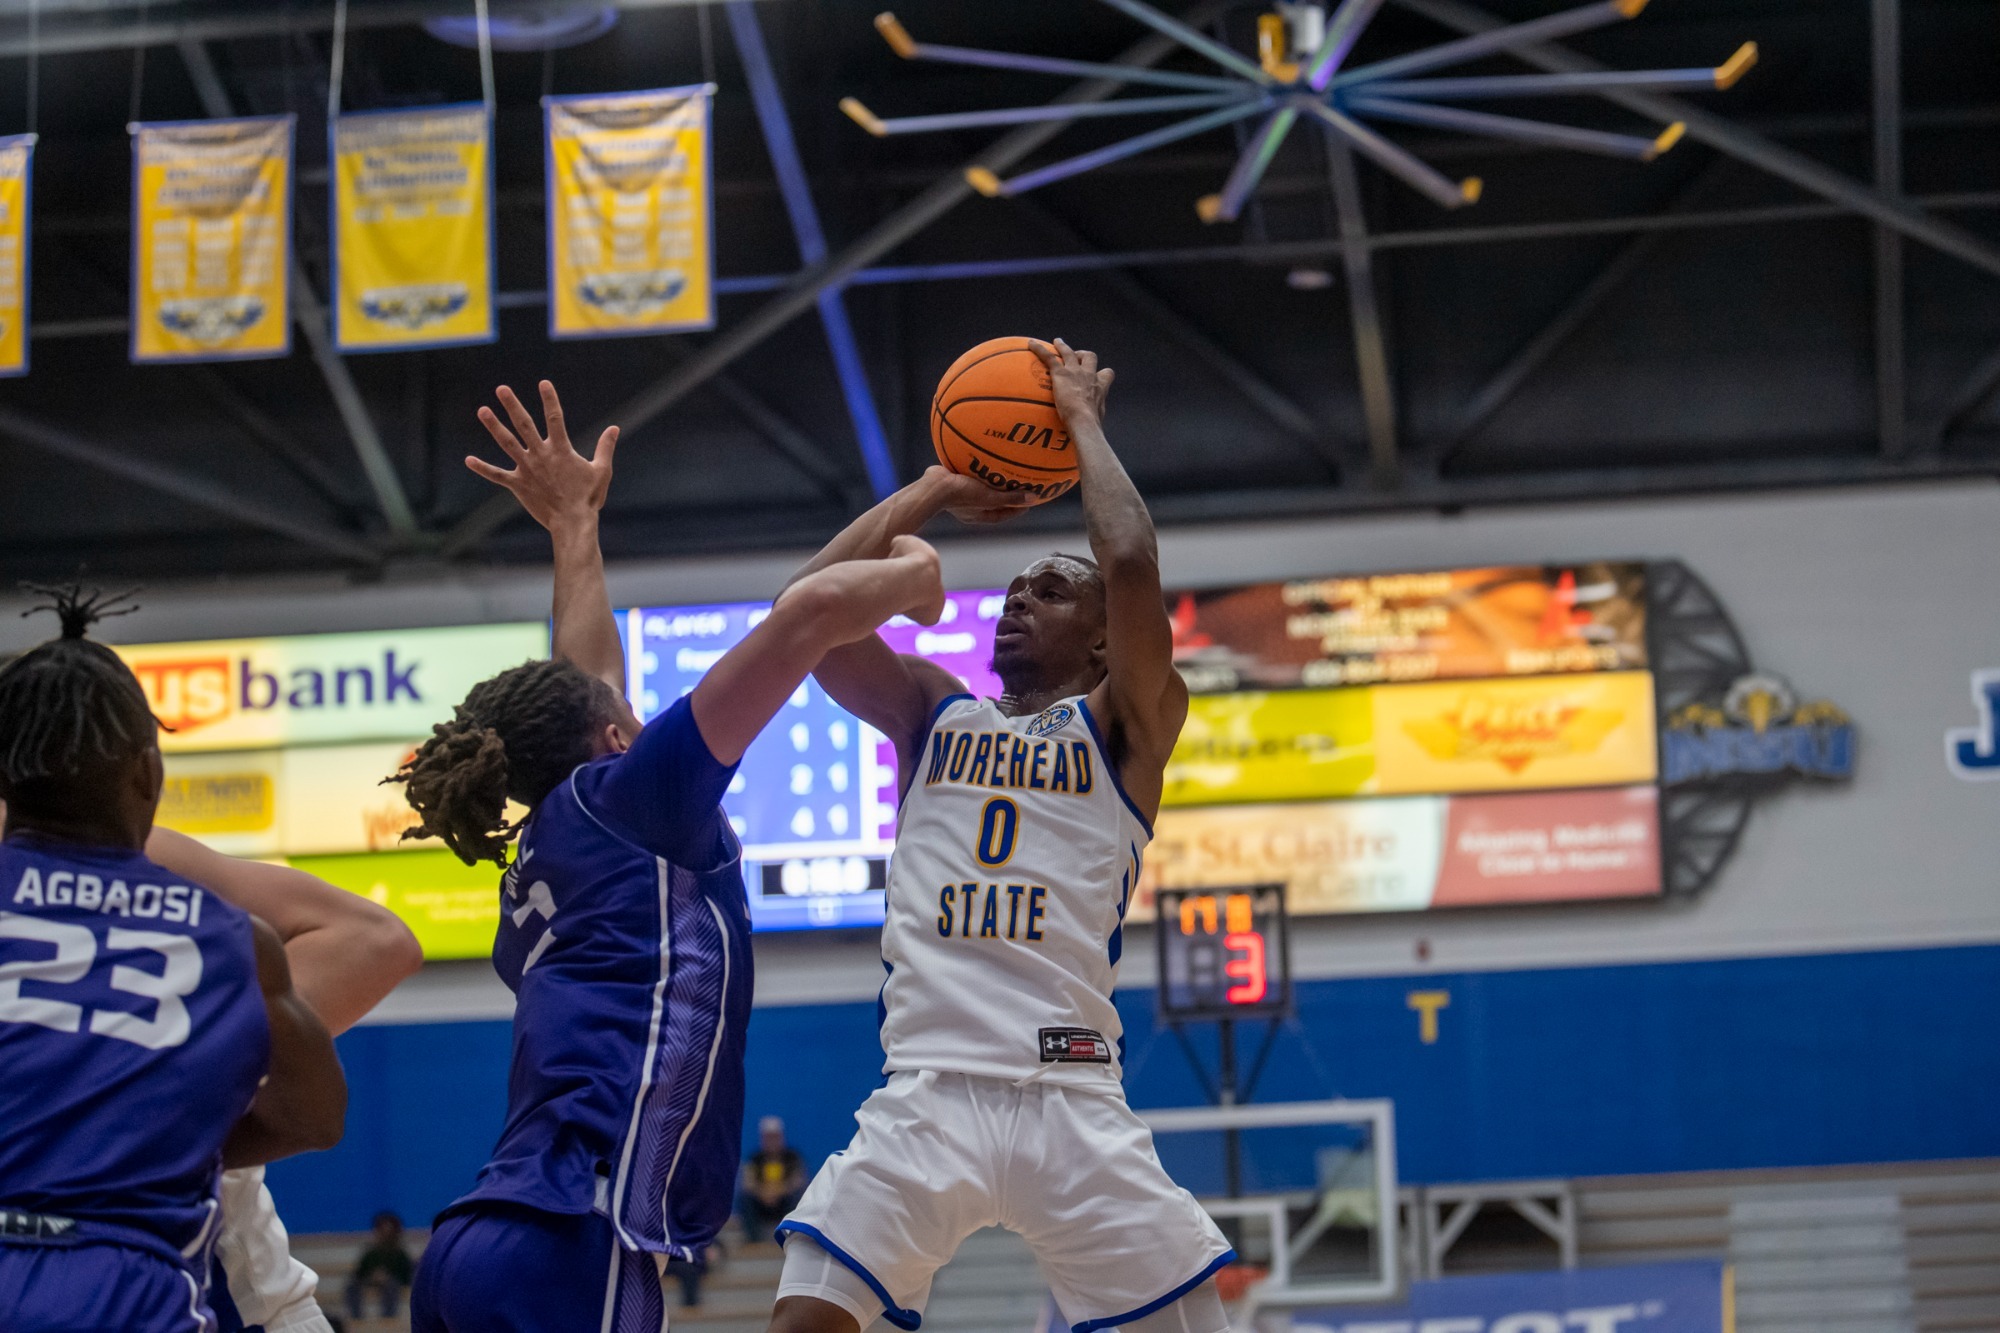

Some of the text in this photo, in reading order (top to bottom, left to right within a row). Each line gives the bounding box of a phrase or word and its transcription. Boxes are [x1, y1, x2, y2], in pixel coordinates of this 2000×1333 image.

[983, 422, 1071, 451] EVO NXT
[239, 650, 420, 710] bank
[925, 730, 1094, 797] MOREHEAD
[974, 795, 1020, 869] 0
[13, 867, 203, 927] AGBAOSI
[937, 882, 1047, 941] STATE
[0, 911, 203, 1050] 23
[1224, 932, 1267, 1005] 3
[1407, 991, 1449, 1043] T
